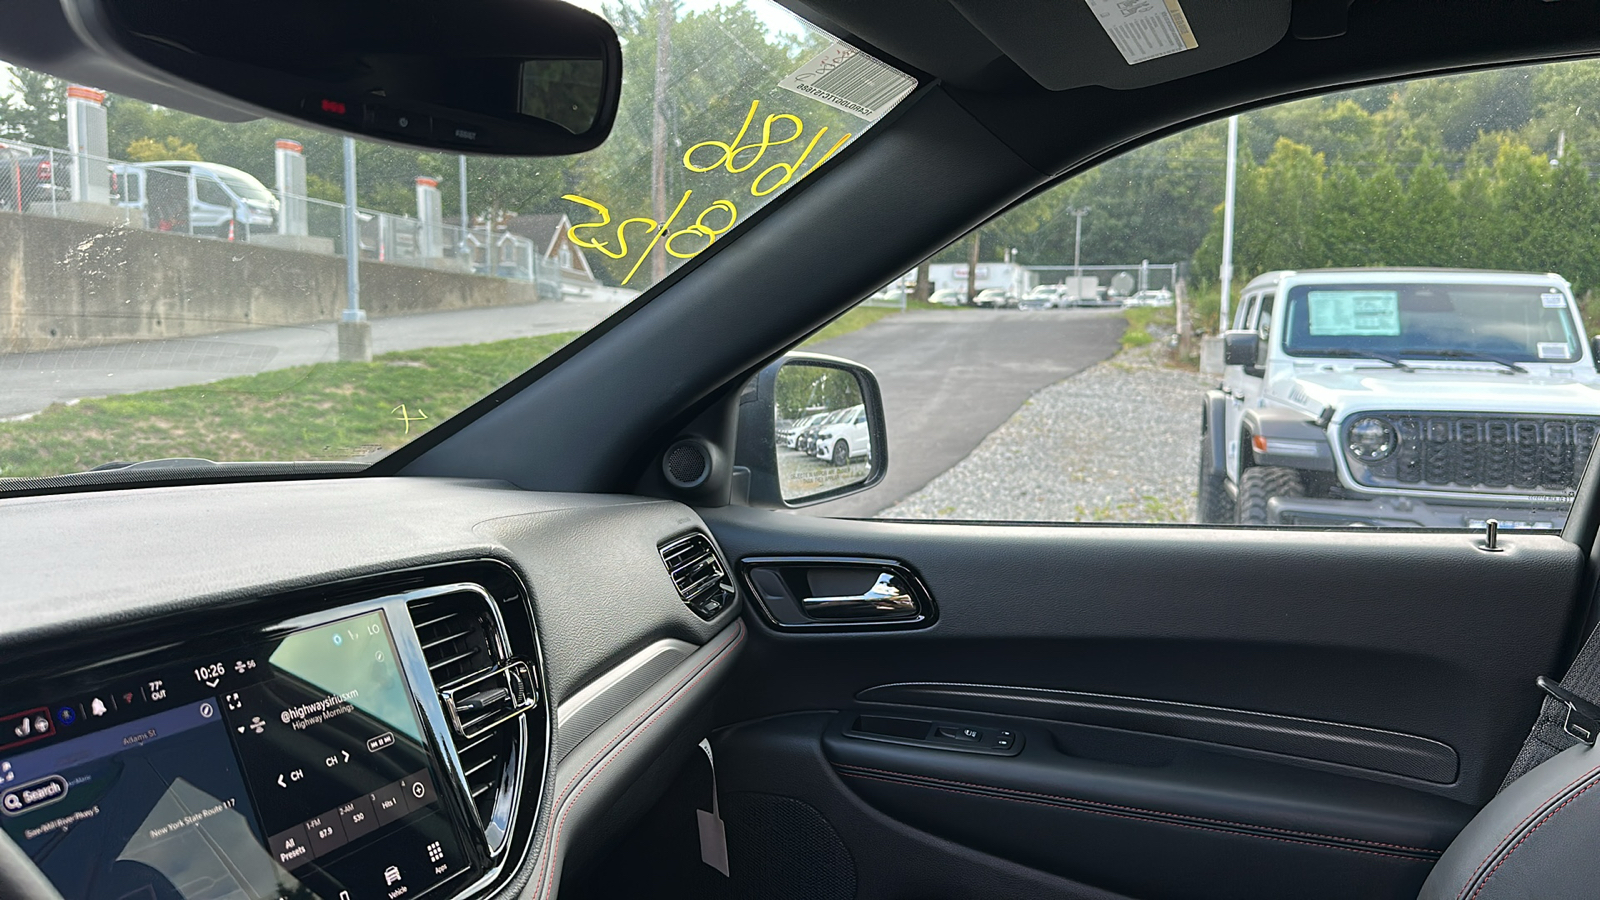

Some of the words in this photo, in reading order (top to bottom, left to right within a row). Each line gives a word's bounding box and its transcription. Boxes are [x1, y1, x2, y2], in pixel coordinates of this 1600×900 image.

[367, 624, 380, 636] LO
[194, 662, 226, 681] 10:26
[151, 689, 167, 701] OUT
[281, 689, 360, 723] @highwaysiriusxm
[291, 715, 323, 731] Highway
[322, 703, 355, 720] Mornings
[123, 733, 148, 745] Adams
[147, 729, 157, 738] St
[325, 755, 339, 767] CH
[290, 768, 304, 781] CH
[22, 780, 62, 803] Search
[340, 803, 355, 816] 2-AM
[381, 800, 394, 810] Hits
[149, 826, 168, 840] New
[167, 819, 185, 832] York
[183, 812, 203, 825] State
[201, 804, 223, 819] Route
[222, 798, 235, 809] 117
[353, 812, 365, 823] 530
[306, 818, 322, 831] 1-FM
[319, 826, 333, 839] 87.9
[285, 838, 296, 850] All
[280, 845, 307, 863] Presets
[435, 863, 448, 875] Apps
[388, 886, 408, 899] Vehicle
